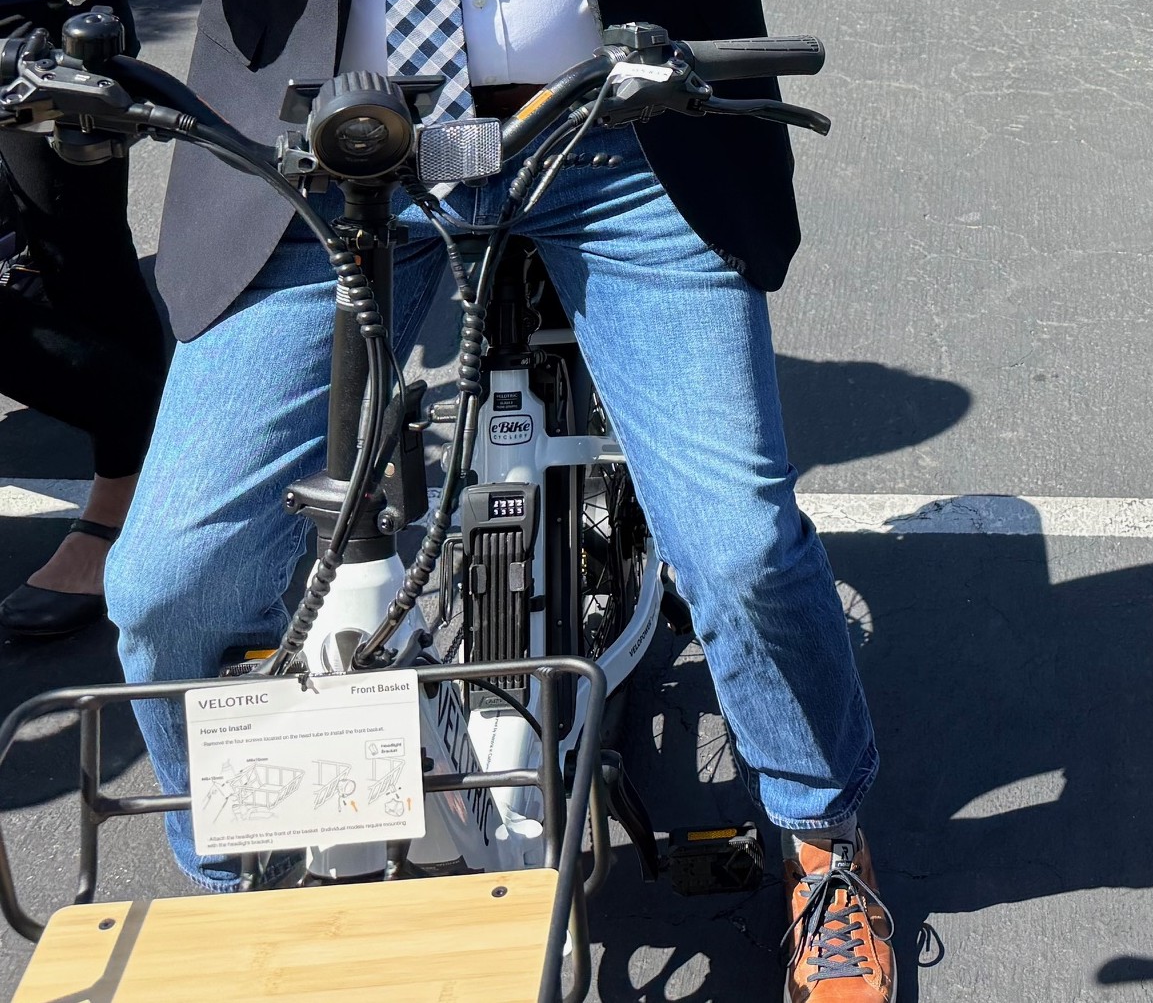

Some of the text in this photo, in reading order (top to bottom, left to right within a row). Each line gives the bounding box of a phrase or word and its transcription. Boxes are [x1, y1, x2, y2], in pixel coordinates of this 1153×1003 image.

[492, 420, 530, 433] eBike
[629, 618, 652, 657] VELOPOWER
[351, 683, 410, 695] Front Basket
[198, 693, 269, 710] VELOTRIC
[229, 724, 252, 732] Install
